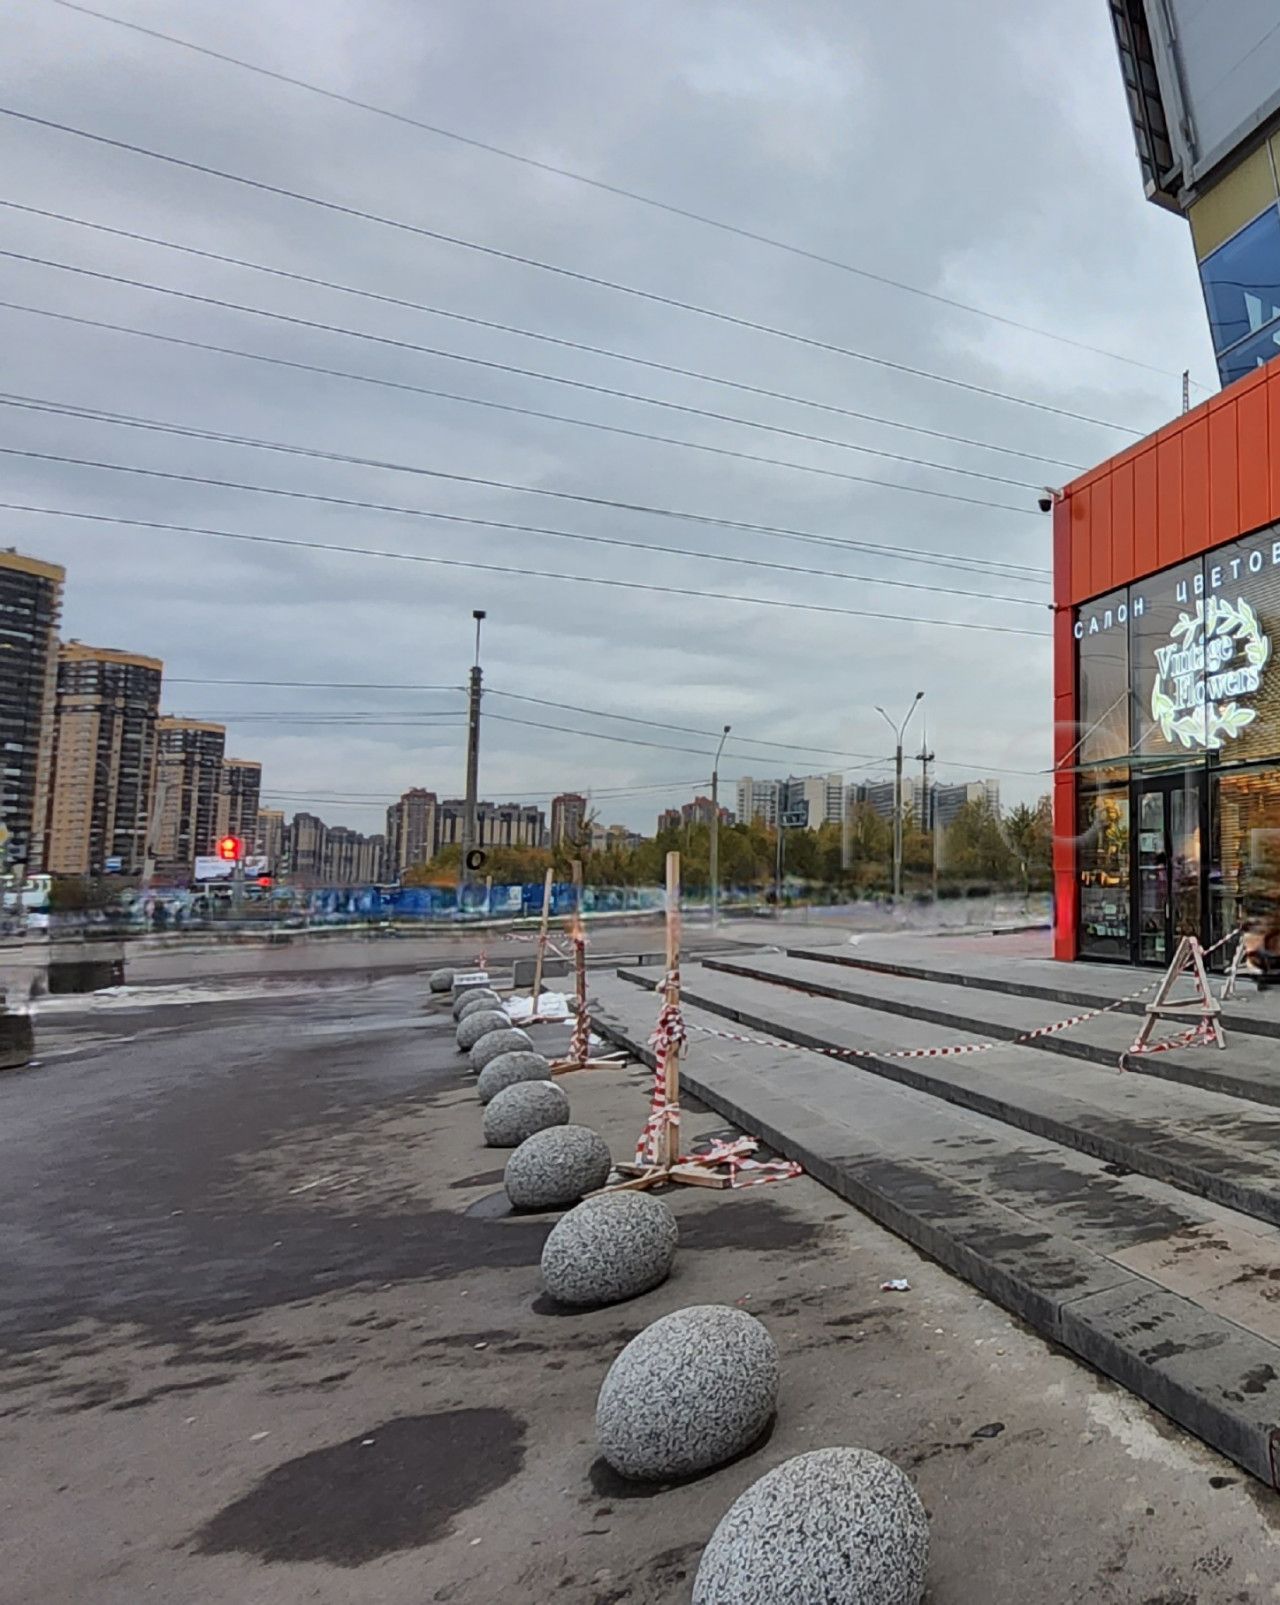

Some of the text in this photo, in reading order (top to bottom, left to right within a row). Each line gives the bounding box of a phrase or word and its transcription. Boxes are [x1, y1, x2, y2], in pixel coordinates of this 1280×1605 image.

[1074, 597, 1144, 639] САЛОН
[1154, 634, 1234, 681] Vintage
[1171, 666, 1260, 711] Flowers
